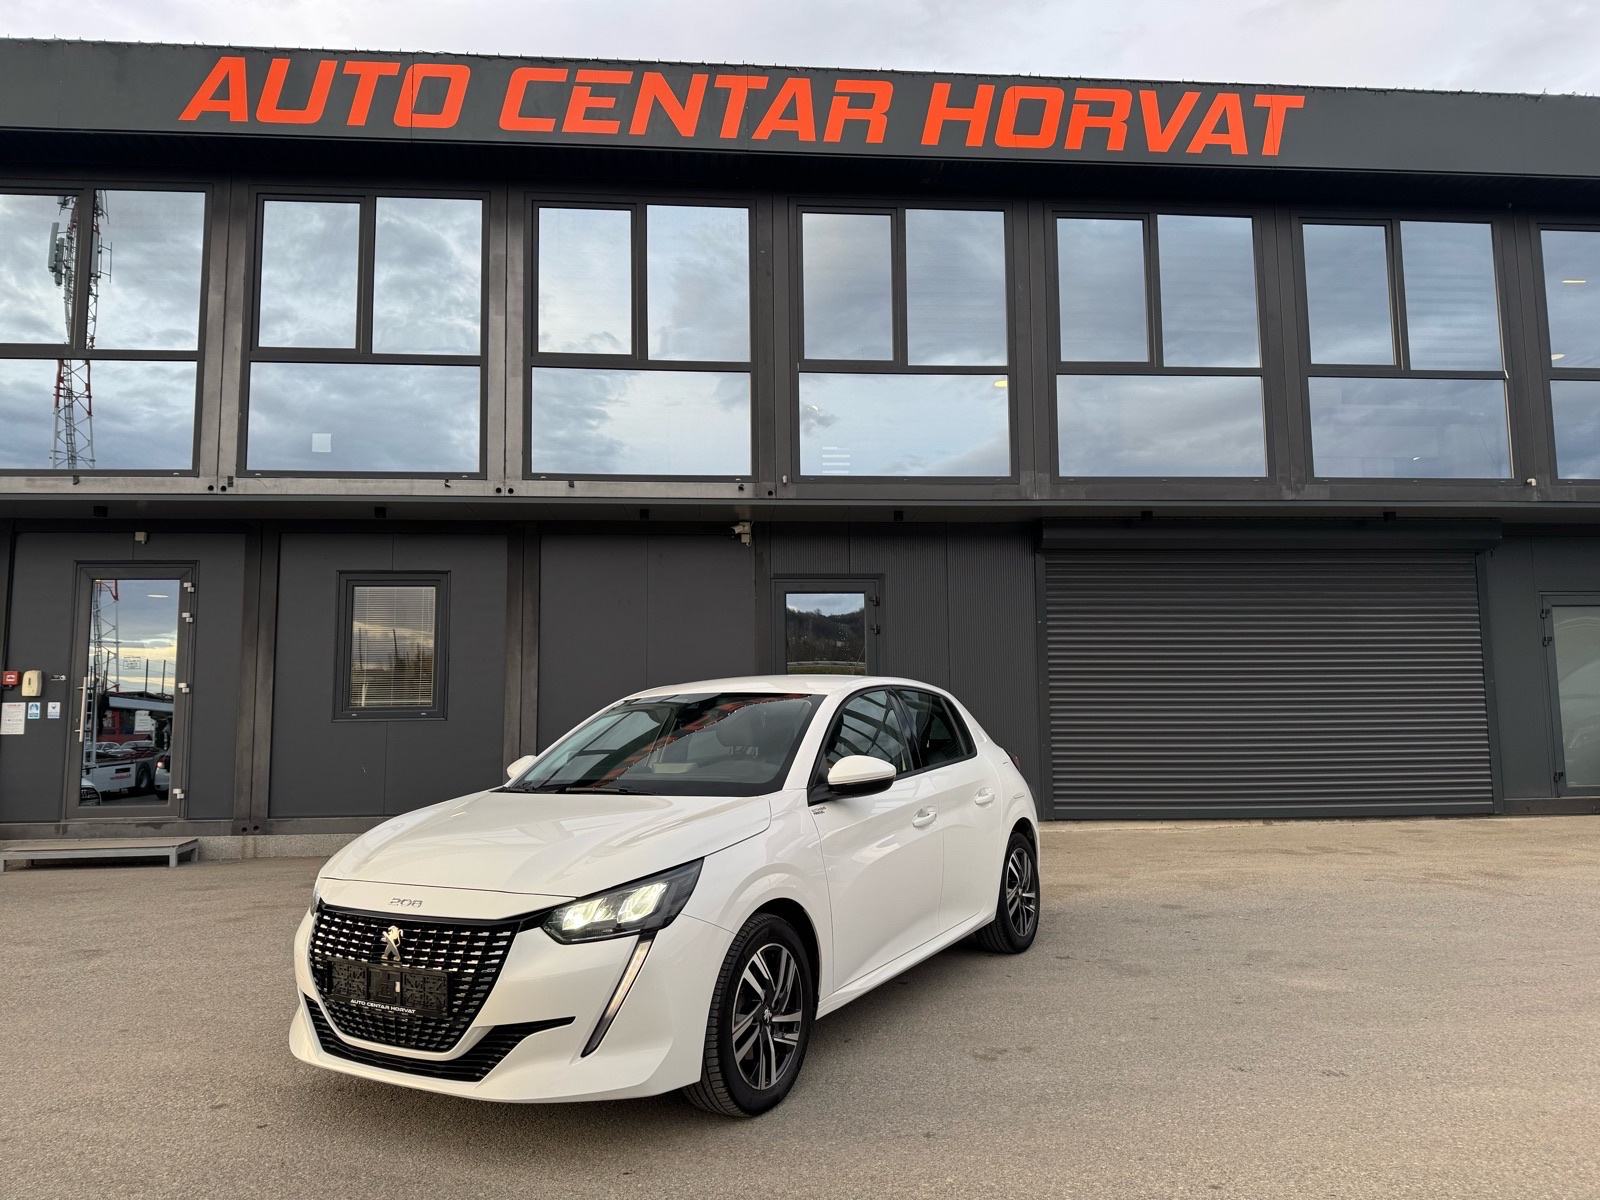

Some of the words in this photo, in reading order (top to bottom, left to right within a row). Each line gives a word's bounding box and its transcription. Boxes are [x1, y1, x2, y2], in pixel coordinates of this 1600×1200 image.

[179, 56, 471, 129] AUTO
[499, 67, 894, 144] CENTAR
[921, 82, 1305, 157] HORVAT
[390, 897, 423, 908] 208
[366, 1001, 390, 1010] CENTAR
[390, 1005, 416, 1014] HORVAT
